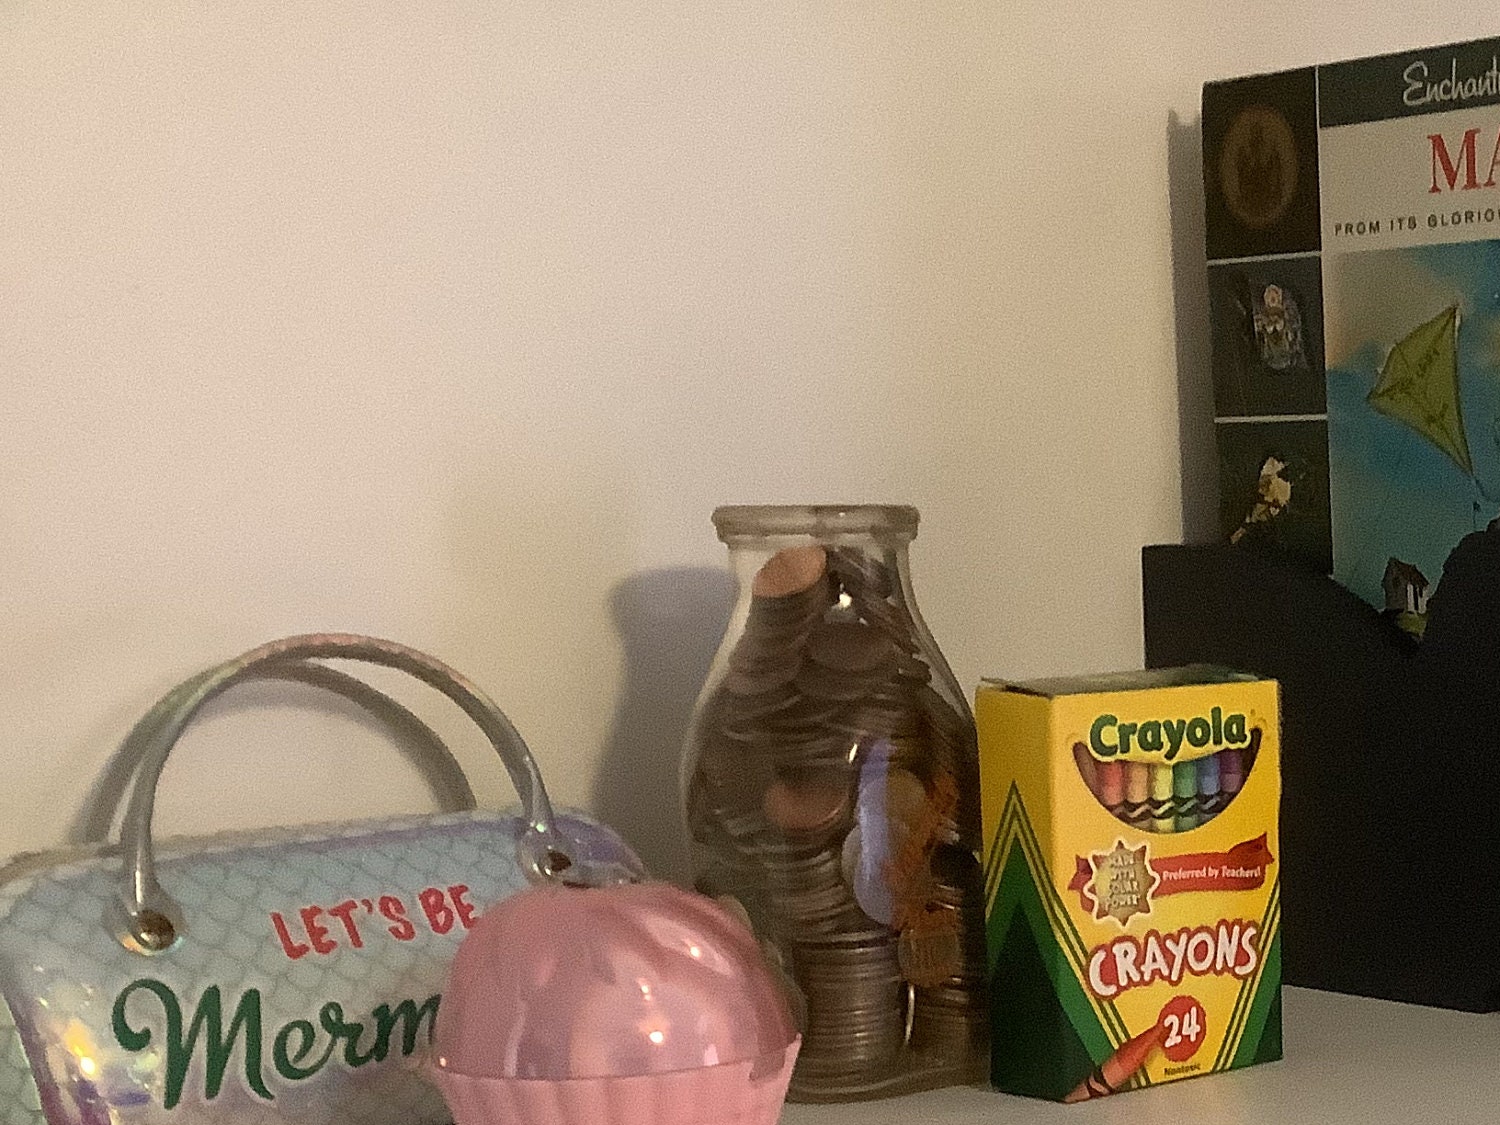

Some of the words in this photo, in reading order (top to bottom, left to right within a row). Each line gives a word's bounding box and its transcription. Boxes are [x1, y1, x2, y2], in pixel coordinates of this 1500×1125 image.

[1334, 218, 1382, 237] FROM
[1389, 216, 1418, 233] ITS
[1090, 707, 1247, 760] Crayola
[1162, 867, 1206, 881] Preferred
[1207, 866, 1219, 879] by
[270, 895, 416, 960] LET'S
[418, 884, 482, 934] BE
[1089, 925, 1257, 995] CRAYONS
[1164, 1006, 1201, 1048] 24
